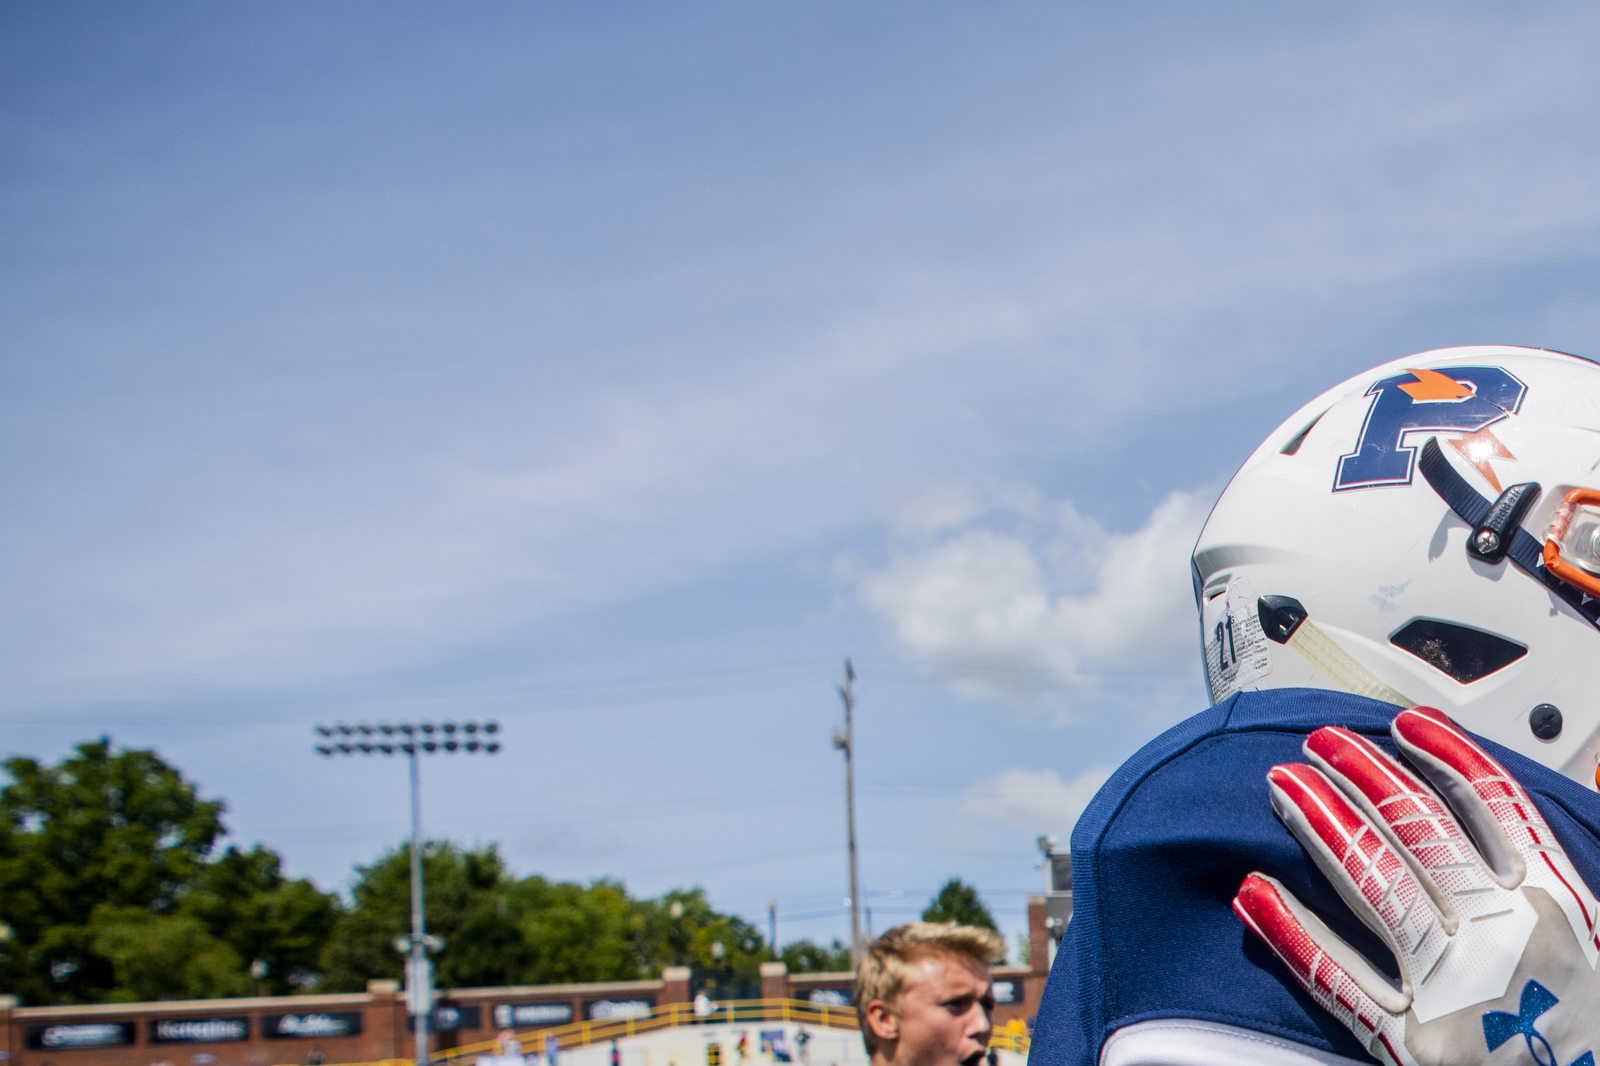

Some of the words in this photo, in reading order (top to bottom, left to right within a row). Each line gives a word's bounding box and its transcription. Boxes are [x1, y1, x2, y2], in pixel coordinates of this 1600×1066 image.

[1333, 366, 1528, 494] P
[1488, 488, 1522, 530] Riddell
[1216, 615, 1237, 672] 21
